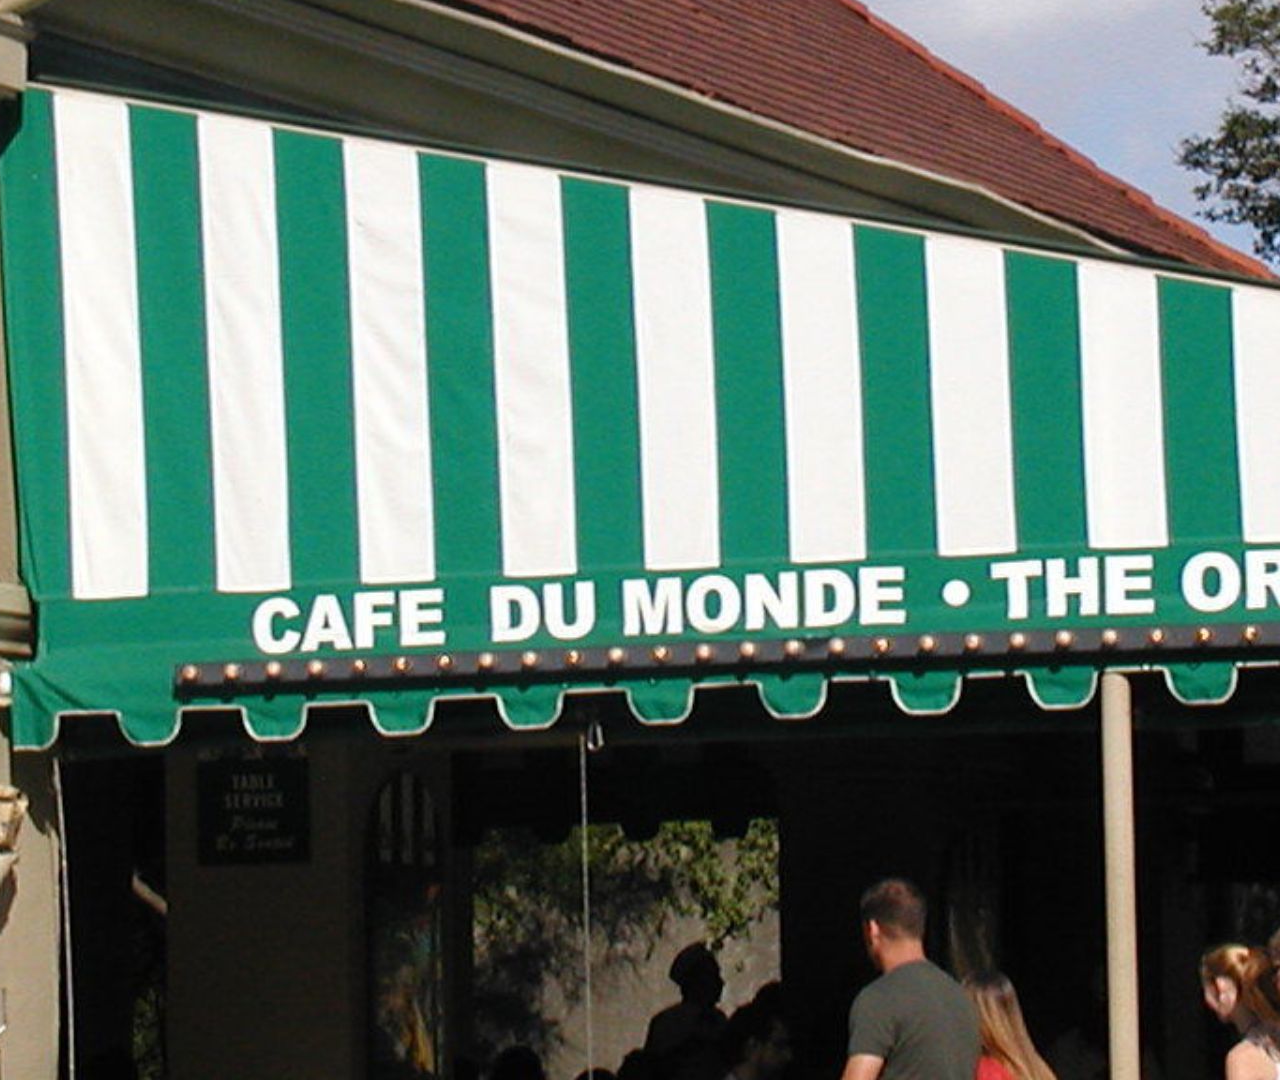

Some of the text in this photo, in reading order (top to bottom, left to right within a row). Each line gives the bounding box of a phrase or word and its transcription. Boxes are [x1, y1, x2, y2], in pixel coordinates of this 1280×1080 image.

[252, 588, 446, 654] CAFE
[490, 581, 596, 643] DU
[622, 566, 907, 637] MONDE
[990, 554, 1155, 620] THE
